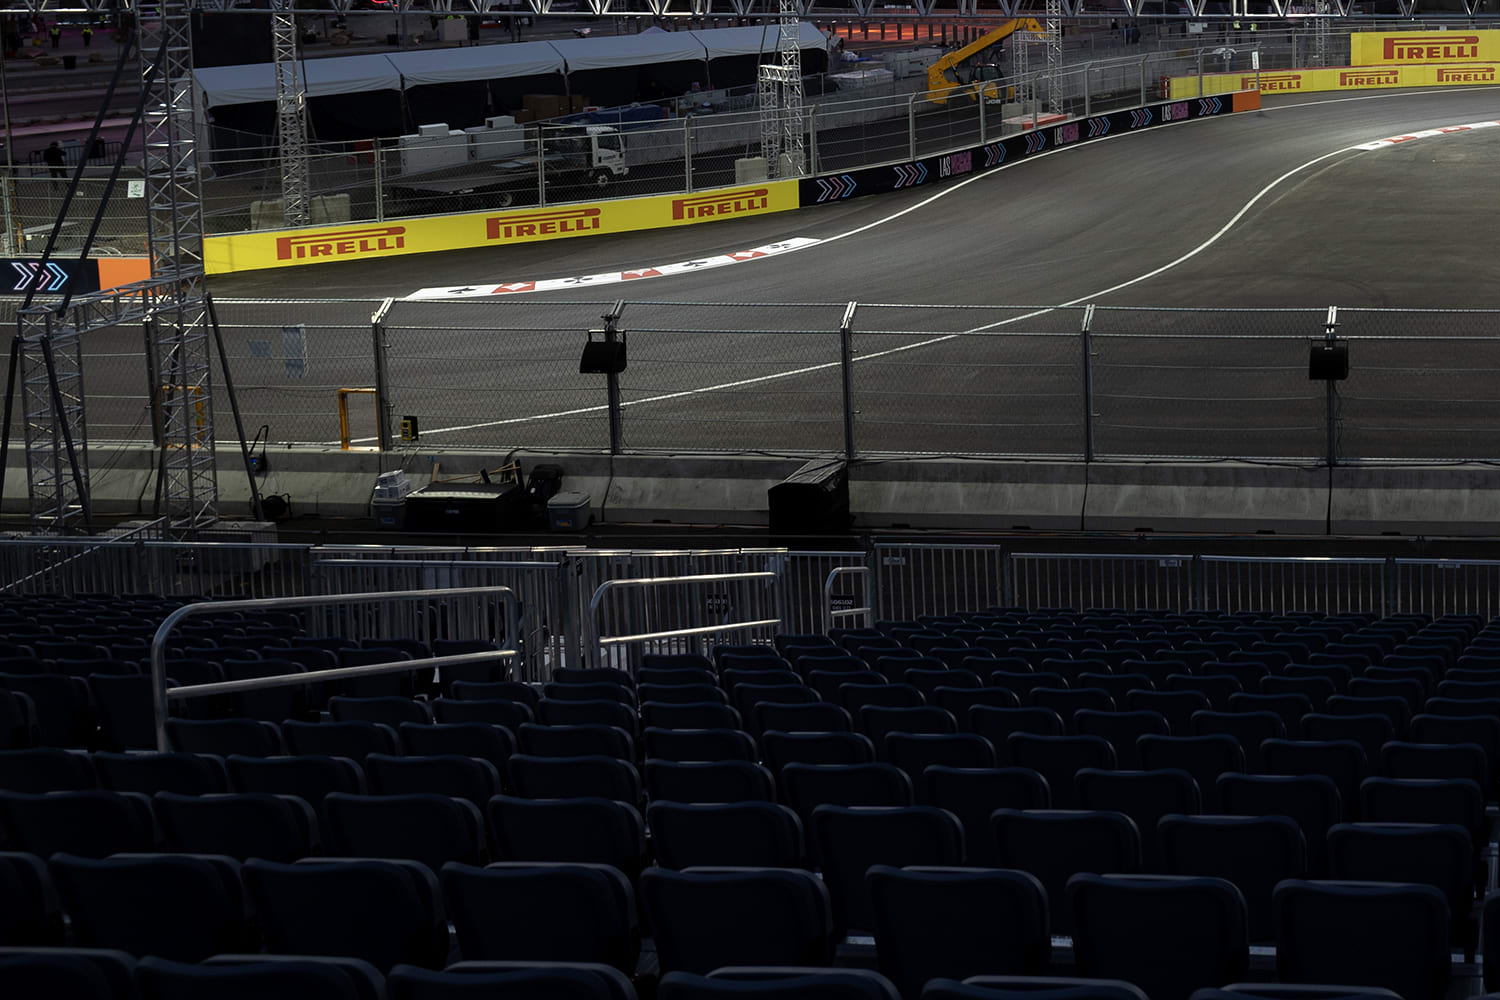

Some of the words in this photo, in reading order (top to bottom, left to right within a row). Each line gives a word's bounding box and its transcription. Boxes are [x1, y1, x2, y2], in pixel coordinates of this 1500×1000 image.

[1383, 36, 1479, 59] PIRELLI
[1340, 70, 1398, 86] PIRELLI
[1437, 67, 1495, 82] PIRELLI
[939, 156, 950, 177] LAS
[672, 188, 768, 220] PIRELLI
[486, 208, 600, 239] PIRELLI
[277, 226, 405, 260] PIRELLI
